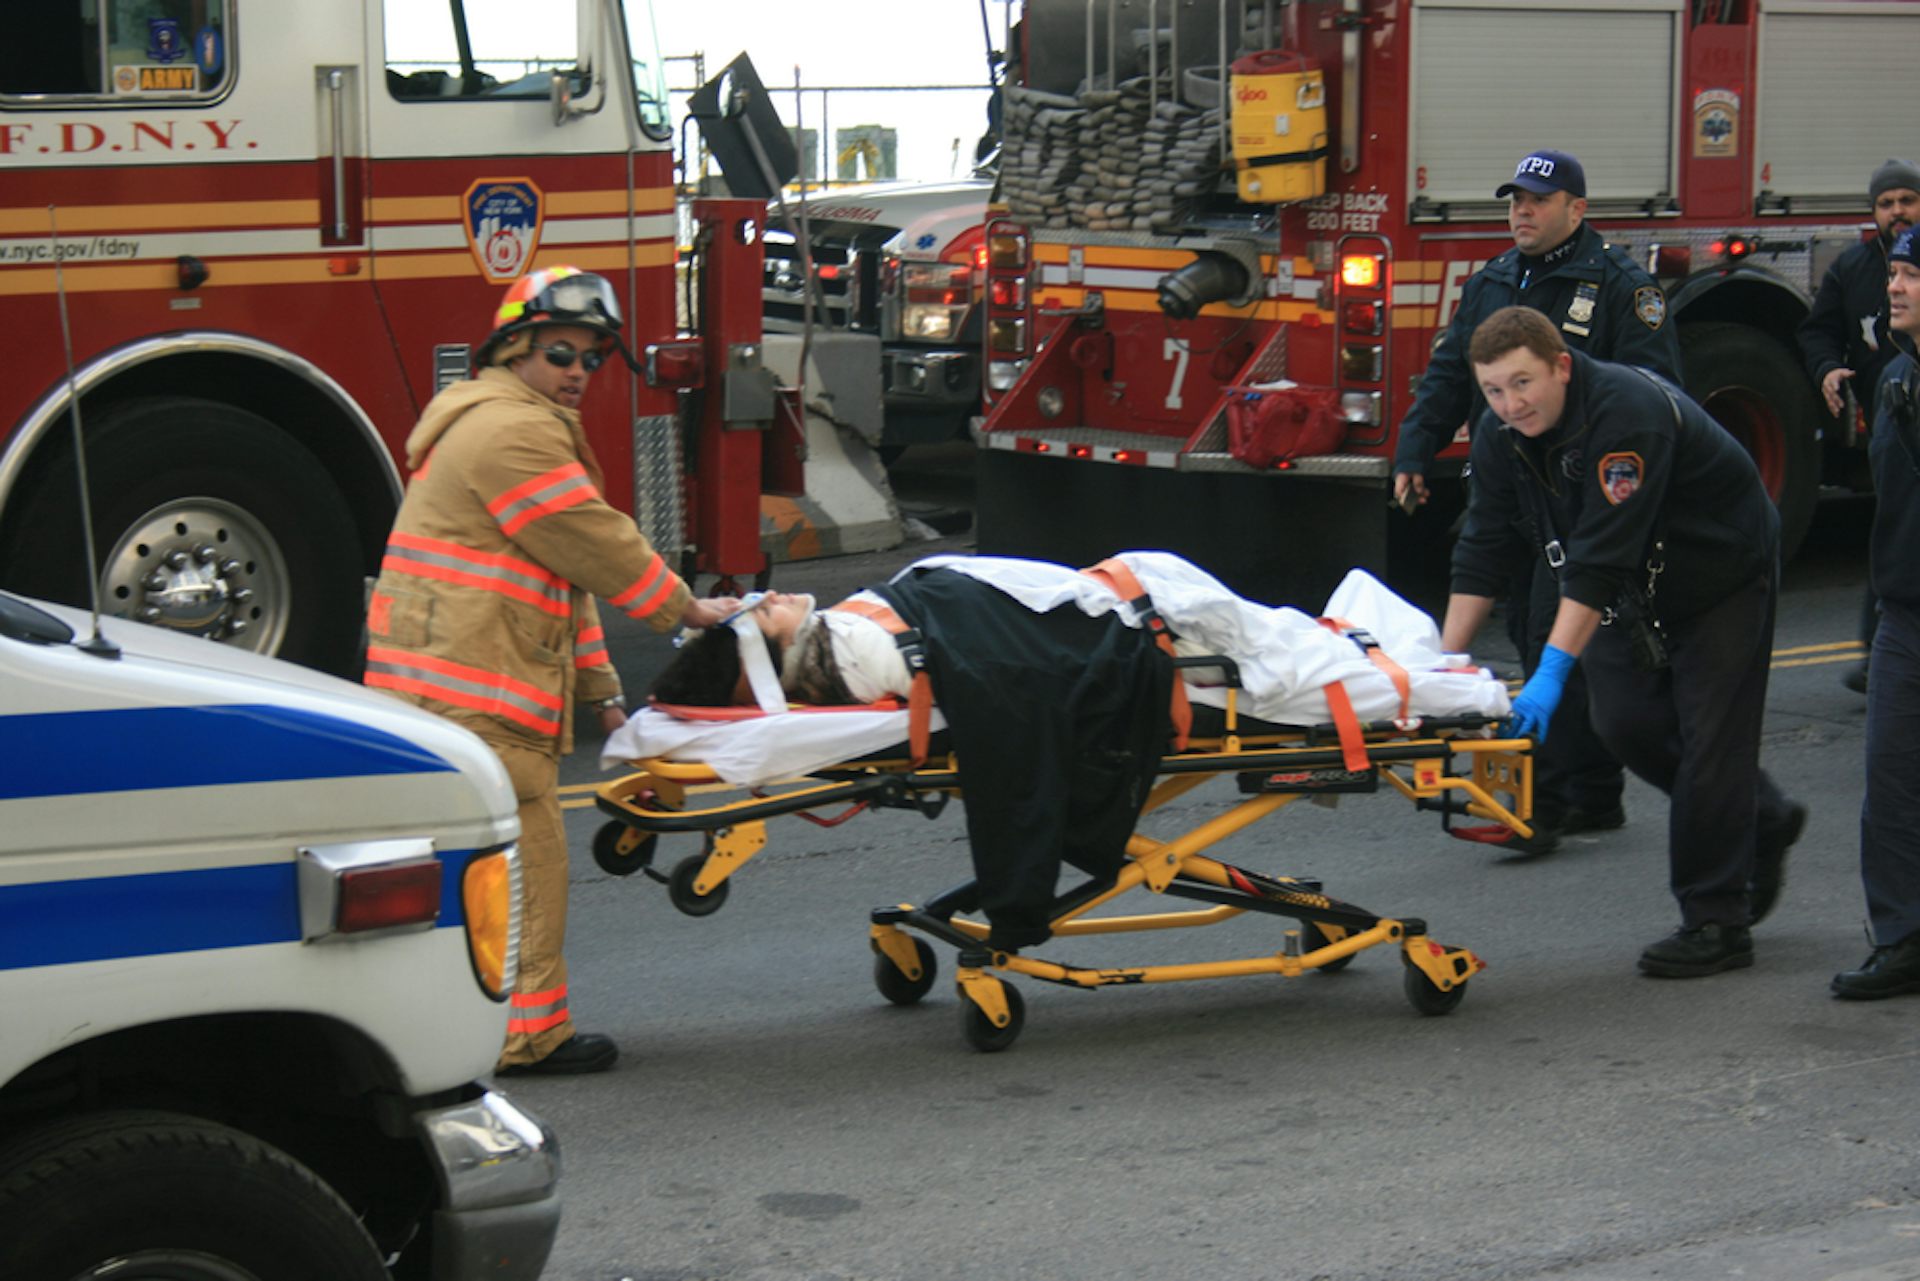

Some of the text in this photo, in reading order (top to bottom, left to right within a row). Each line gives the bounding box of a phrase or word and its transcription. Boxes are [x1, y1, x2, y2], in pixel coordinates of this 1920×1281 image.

[141, 68, 193, 89] ARMY
[1416, 166, 1427, 190] 6
[1343, 192, 1388, 212] BACK
[1306, 212, 1380, 232] 200 FEET
[1163, 338, 1189, 409] 7
